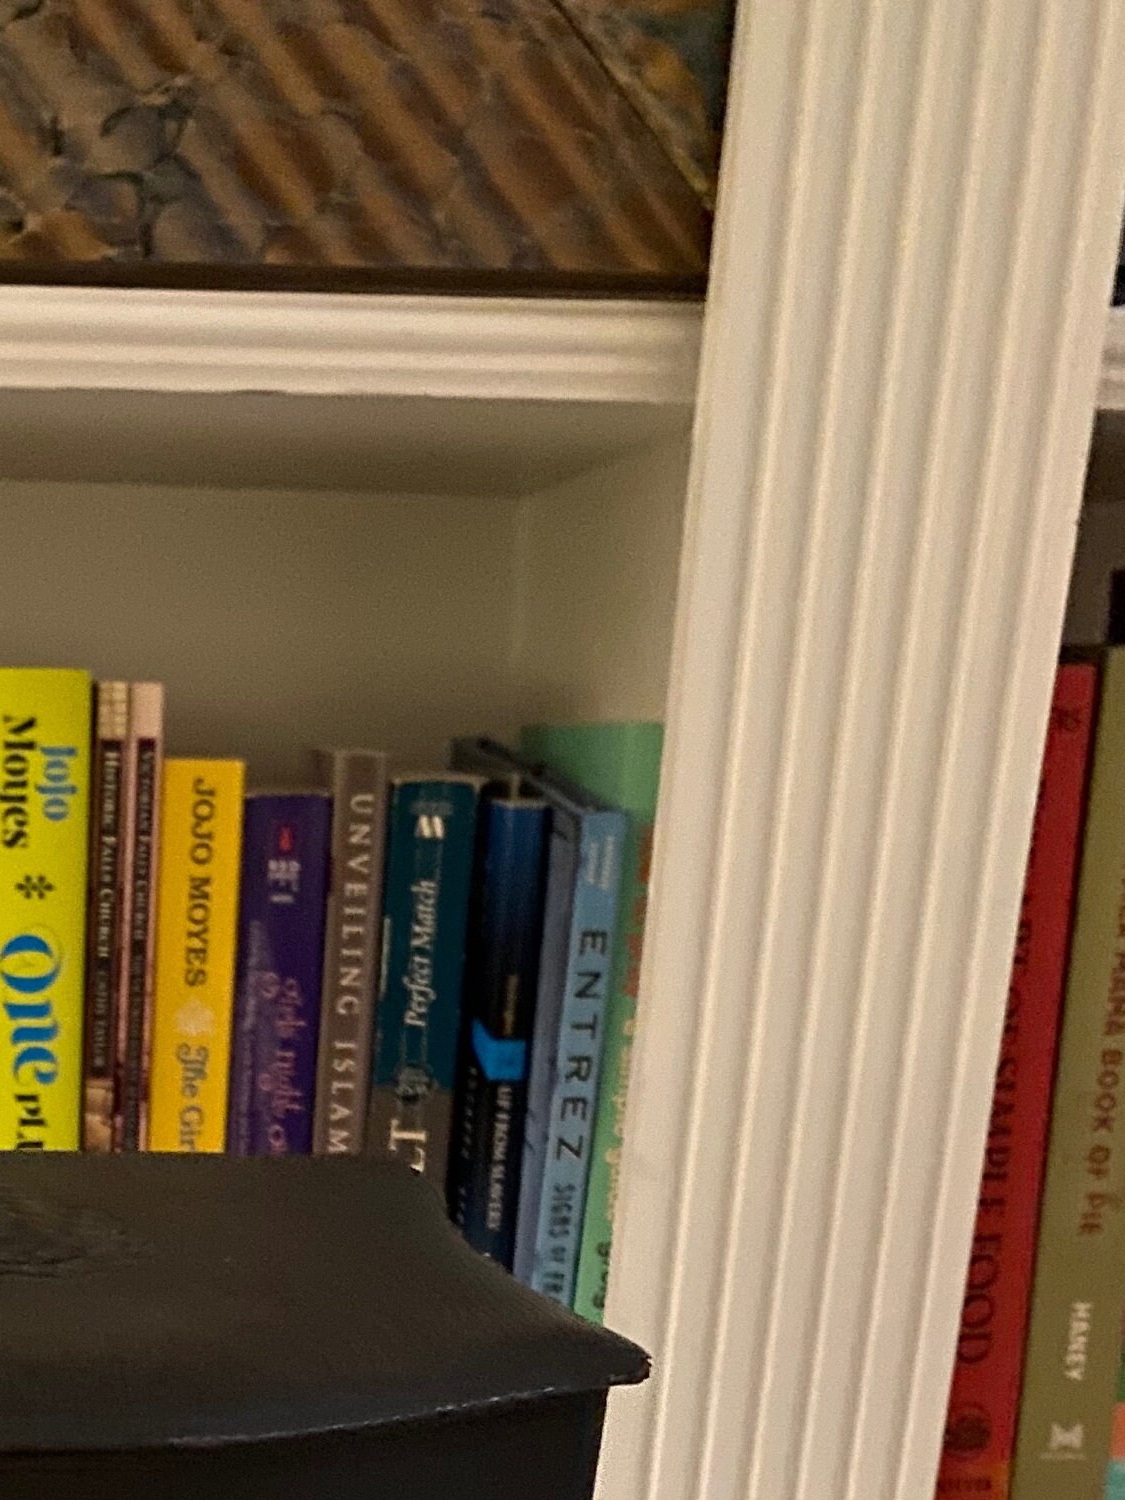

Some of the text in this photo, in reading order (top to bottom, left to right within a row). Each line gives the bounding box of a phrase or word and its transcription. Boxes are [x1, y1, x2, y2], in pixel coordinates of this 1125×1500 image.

[100, 750, 120, 834] HISTORIC
[189, 777, 216, 865] JOJO
[97, 835, 118, 882] FALLS
[96, 887, 117, 958] CHURCH
[183, 875, 213, 988] MOYES
[403, 879, 438, 1029] Perfect Match
[326, 793, 374, 1153] UNVEILING ISLAM
[176, 1042, 210, 1097] The
[556, 929, 608, 1164] ENTREZ
[1092, 1048, 1123, 1133] BOOK
[487, 1085, 513, 1231] UP FROM SLAVERY
[1087, 1144, 1112, 1182] OF
[958, 1233, 1005, 1366] FOOD
[1064, 1301, 1092, 1382] HANEY
